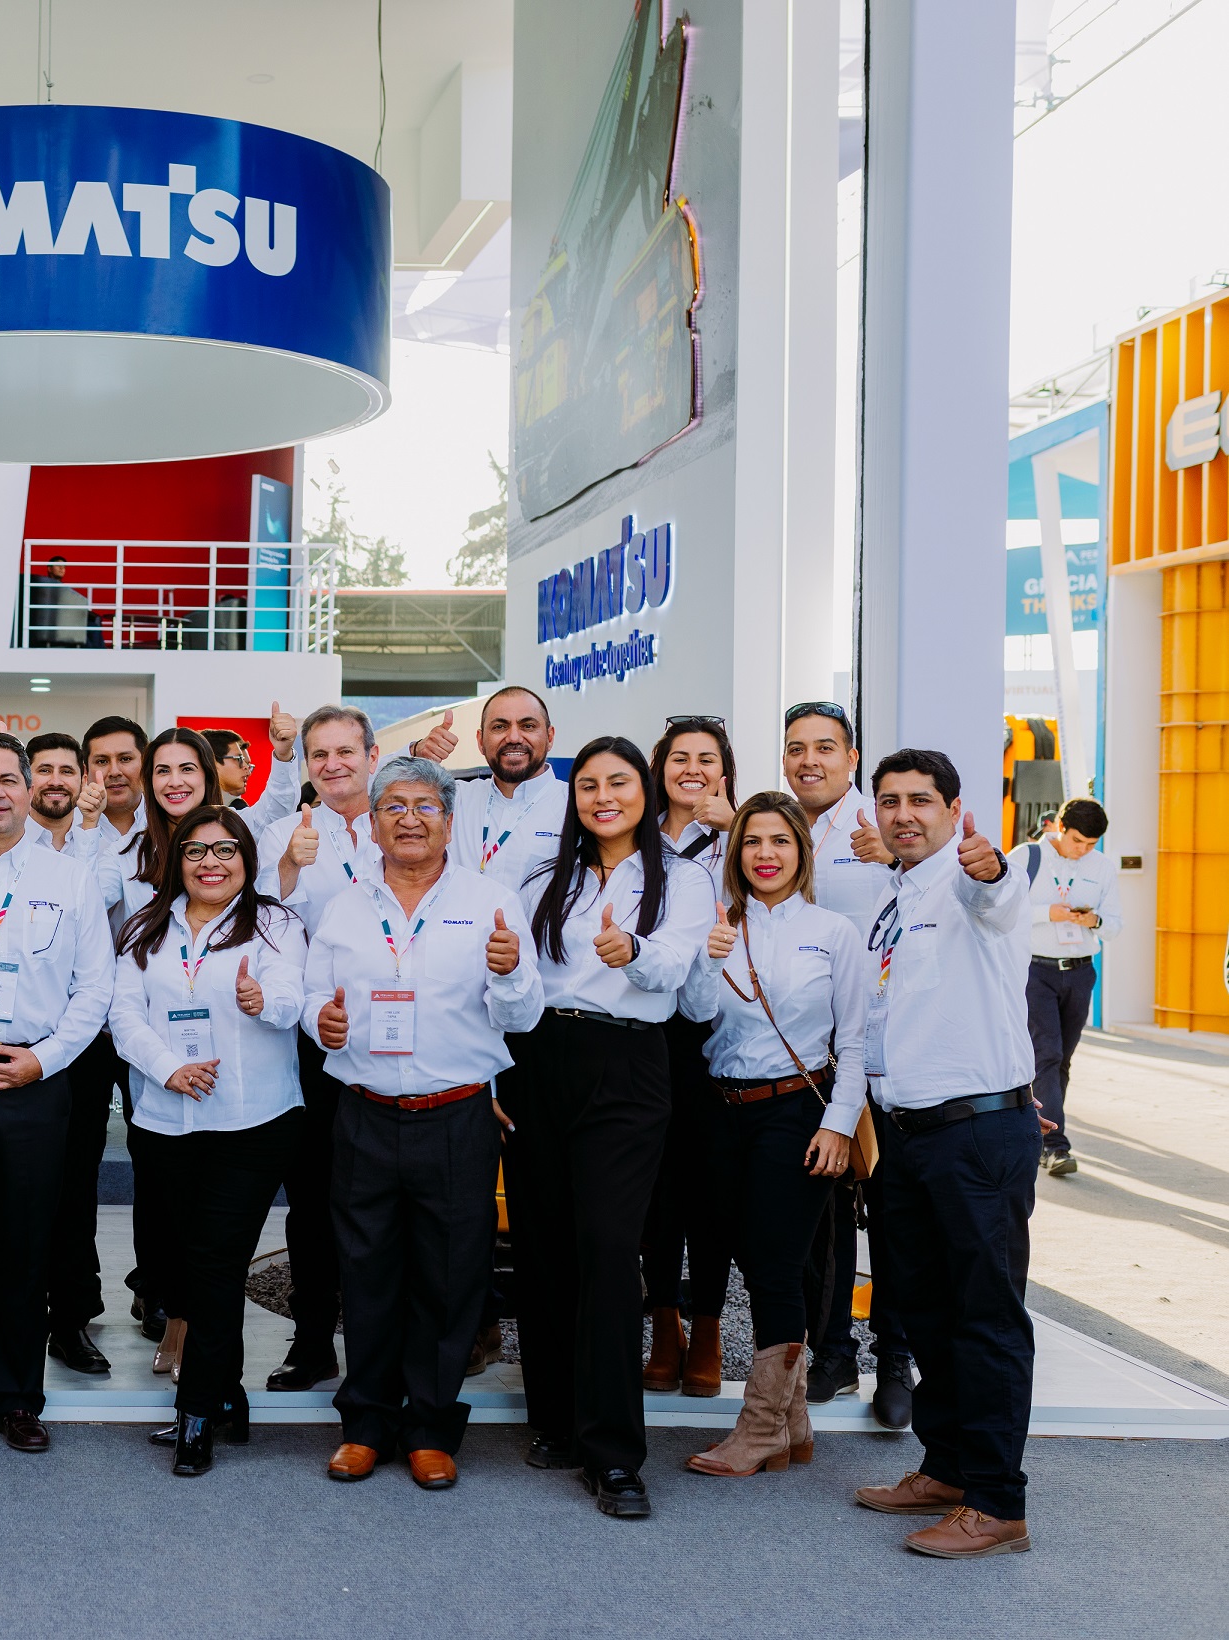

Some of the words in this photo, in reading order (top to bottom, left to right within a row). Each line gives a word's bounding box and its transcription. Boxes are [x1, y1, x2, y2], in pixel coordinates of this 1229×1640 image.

[1165, 390, 1229, 472] E
[538, 515, 671, 645] KOMATSU
[1021, 593, 1097, 615] THKS
[546, 652, 582, 692] Creating
[581, 642, 606, 681] value
[605, 629, 655, 682] together
